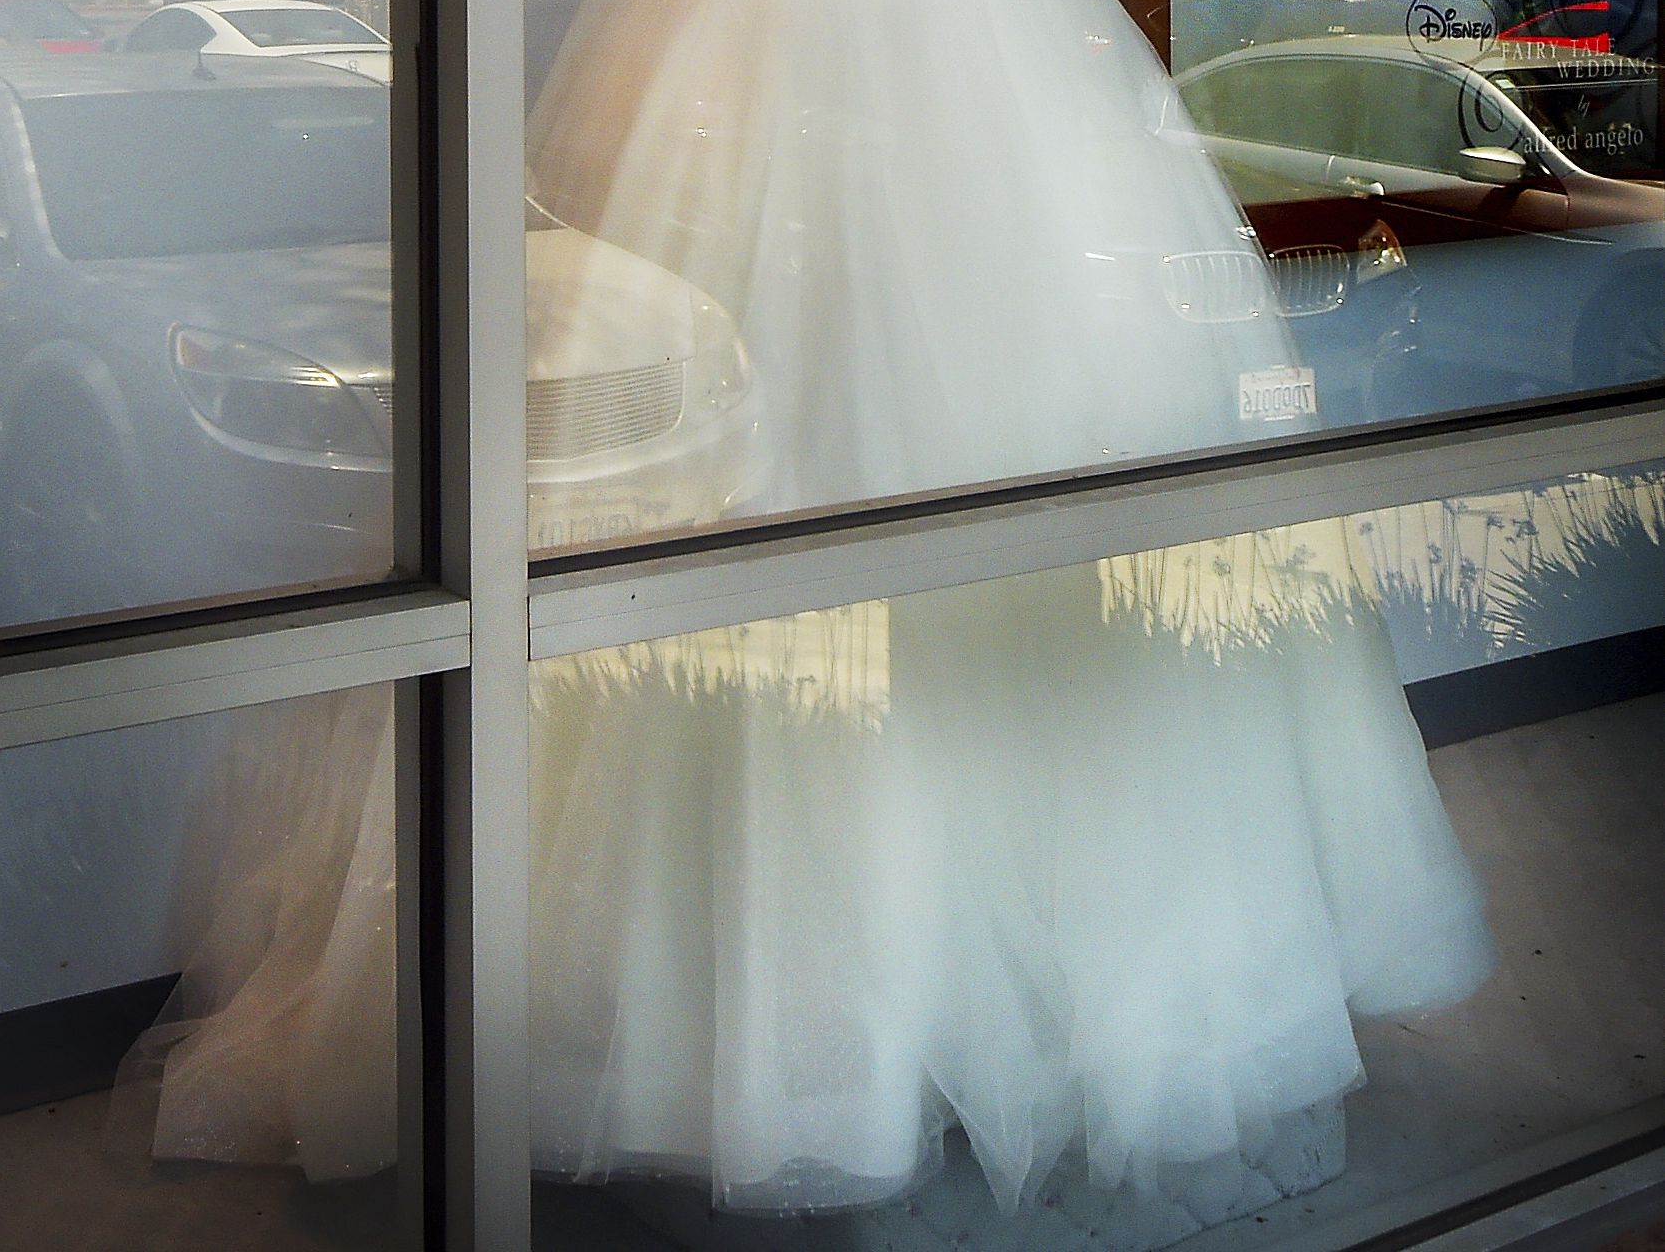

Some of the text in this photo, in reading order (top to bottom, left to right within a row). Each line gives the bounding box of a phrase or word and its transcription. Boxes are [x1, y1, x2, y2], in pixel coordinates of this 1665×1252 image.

[1501, 36, 1616, 61] FAIRY TALE
[1556, 56, 1656, 79] WEDDING
[1523, 122, 1644, 156] alfred angelo
